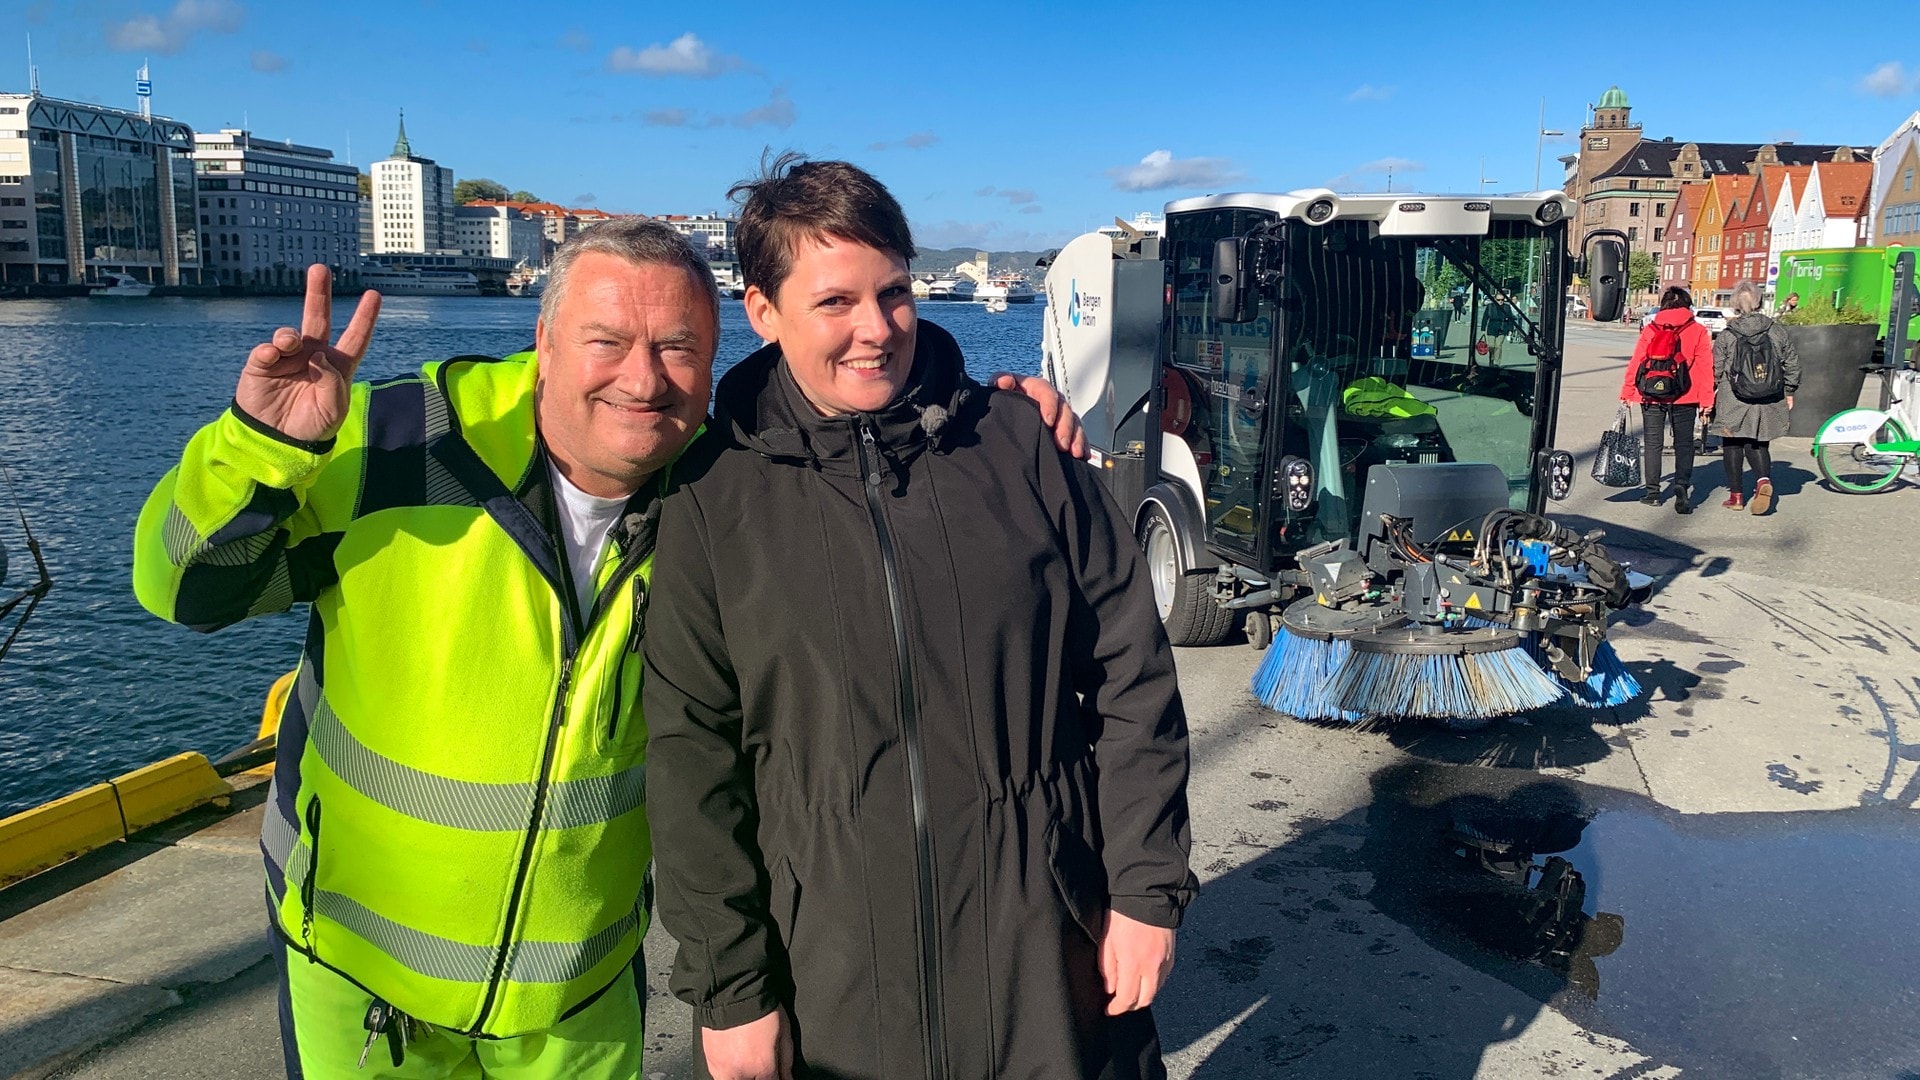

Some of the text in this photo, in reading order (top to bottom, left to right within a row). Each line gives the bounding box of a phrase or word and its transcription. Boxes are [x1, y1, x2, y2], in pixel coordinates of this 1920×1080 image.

[1797, 262, 1823, 281] bring
[1082, 292, 1101, 312] Bergen
[1082, 311, 1096, 327] Havn
[1614, 453, 1637, 468] ONLY
